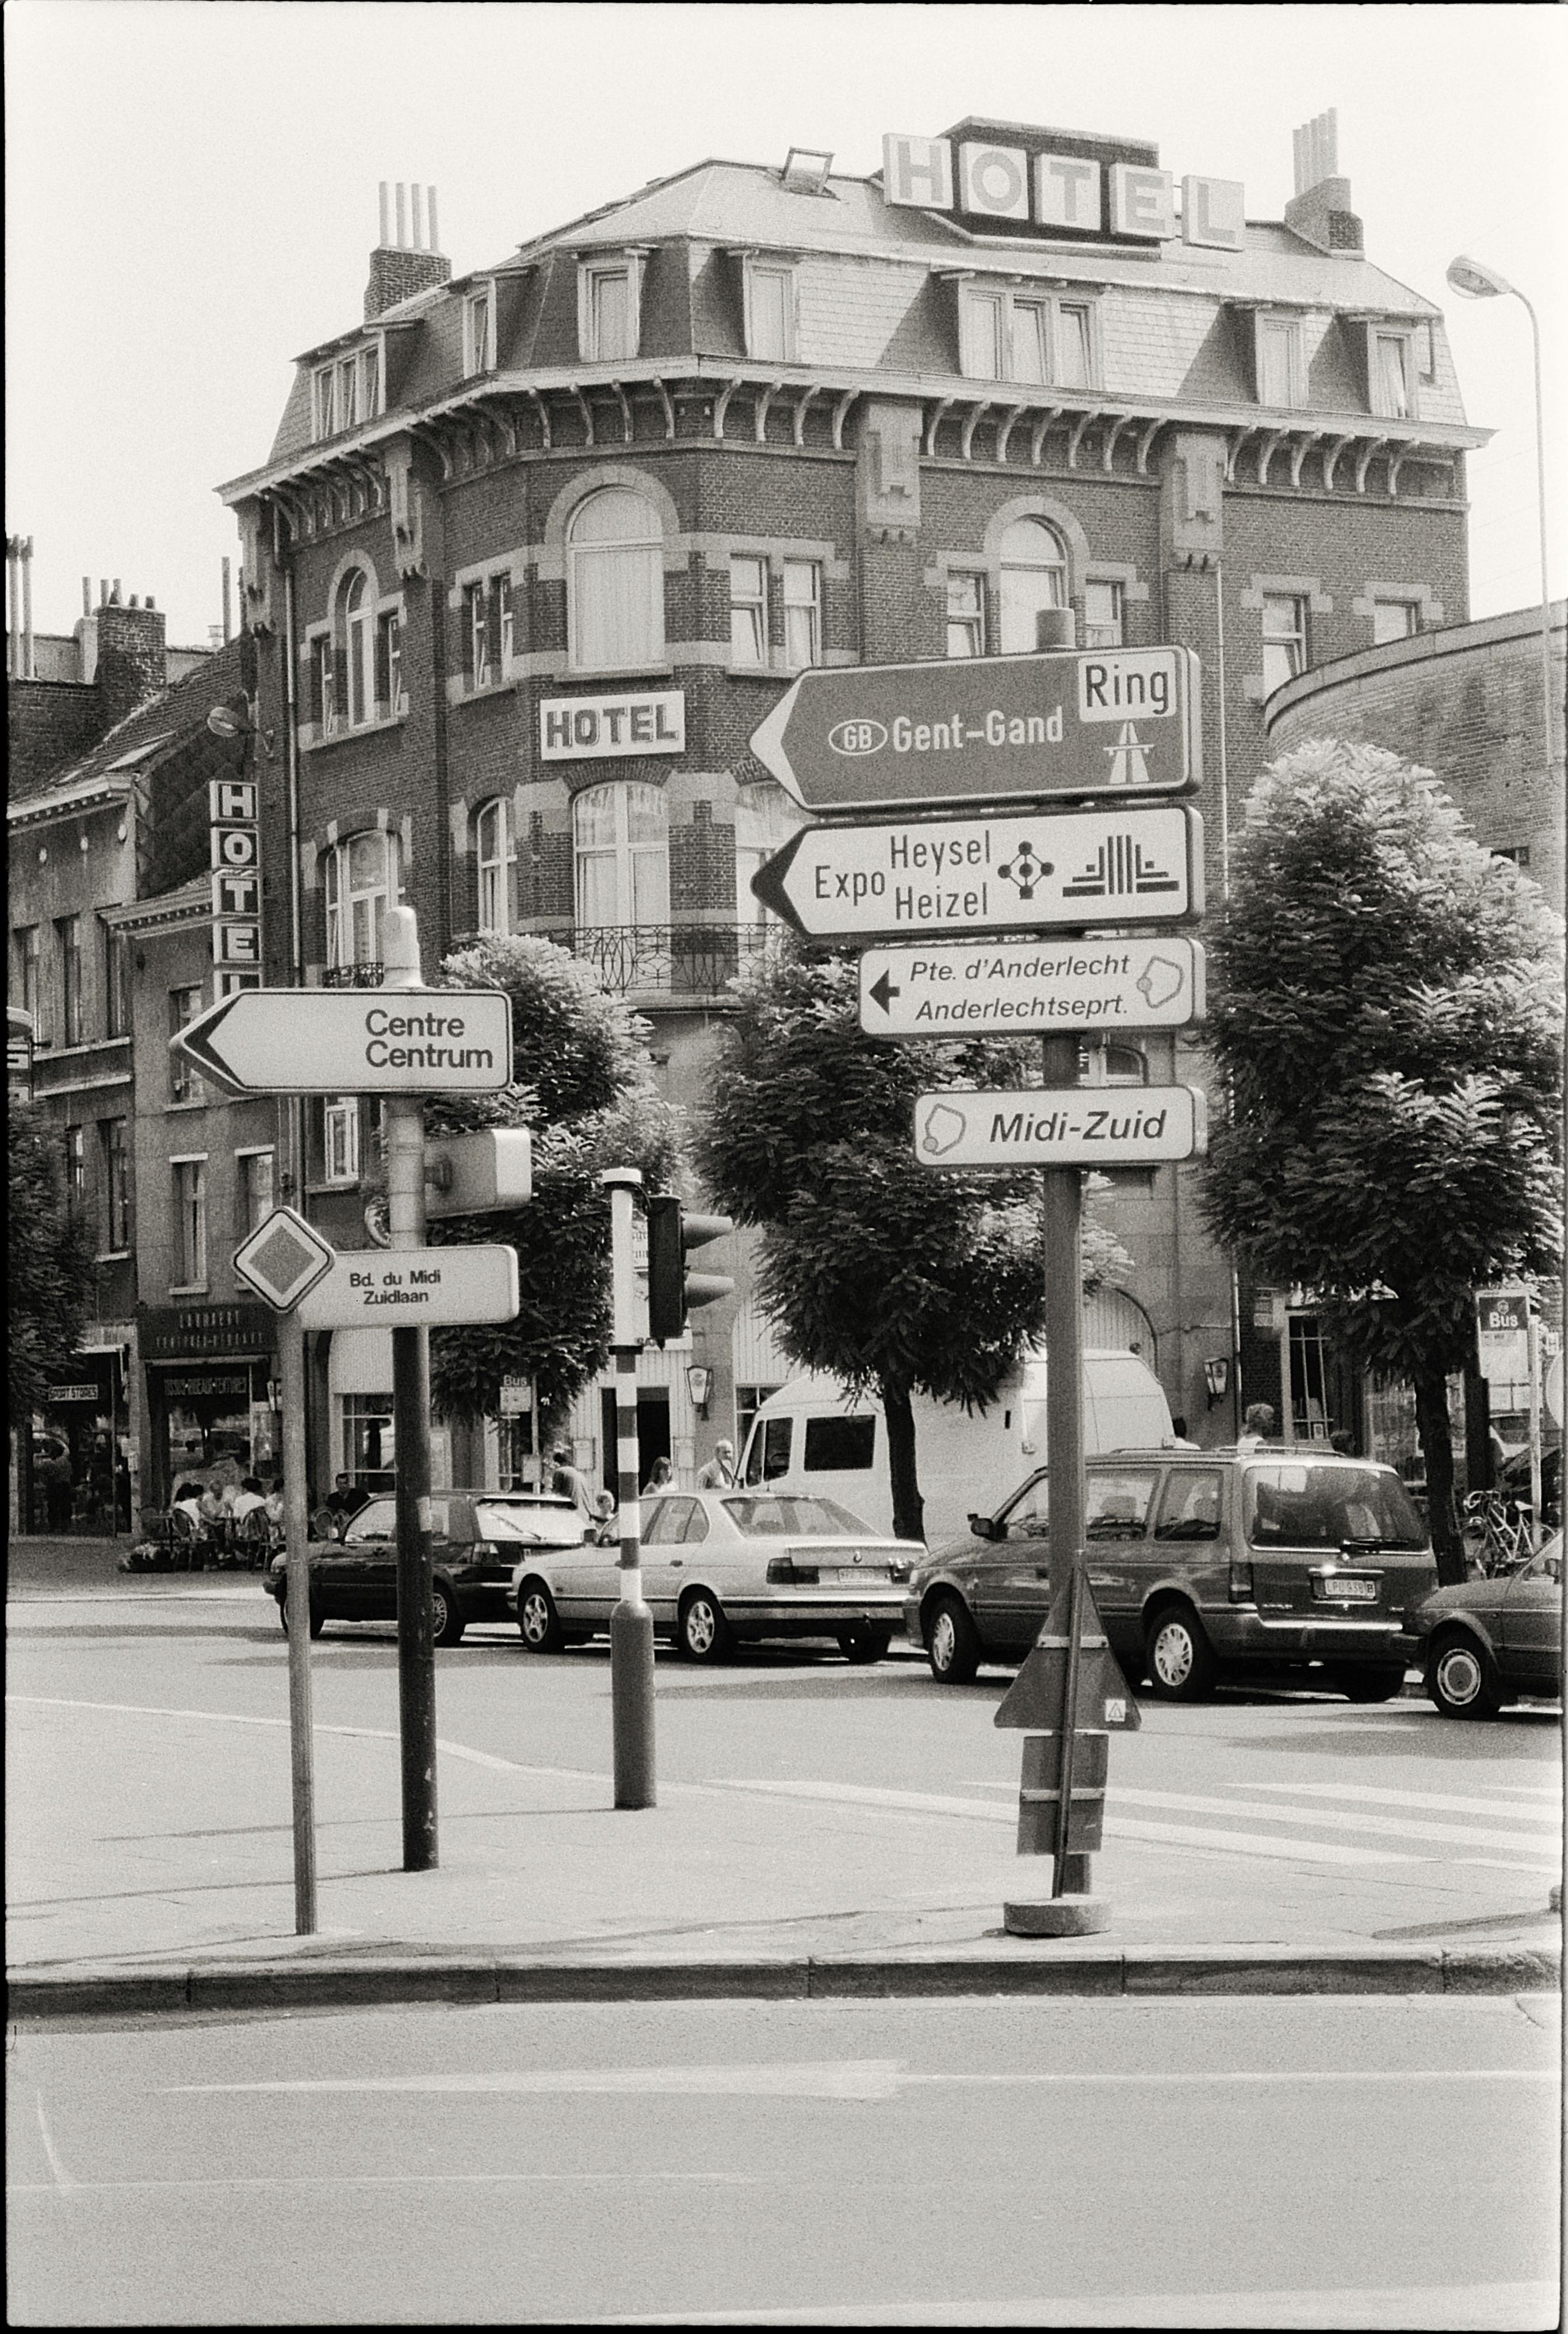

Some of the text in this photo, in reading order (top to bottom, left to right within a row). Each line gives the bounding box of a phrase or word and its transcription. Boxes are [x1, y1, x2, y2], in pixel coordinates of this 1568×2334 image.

[896, 140, 1238, 244] HOTEL
[1085, 664, 1169, 715] Ring
[546, 704, 679, 748] HOTEL
[843, 705, 1063, 752] GB Gent-Gand
[890, 829, 990, 876] Heysel
[815, 864, 886, 906] Expo
[895, 882, 988, 920] Heizel
[910, 954, 1130, 981] Pte. d'Anderlecht
[365, 1009, 465, 1038] Centre
[915, 994, 1127, 1021] Anderlechtseprt.
[365, 1039, 493, 1069] Centrum
[990, 1109, 1167, 1143] Midi-Zuid
[349, 1269, 441, 1288] Bd. du Midi
[363, 1290, 429, 1306] Zuidlaan
[1489, 1312, 1519, 1328] Bus
[503, 1374, 527, 1386] Bus
